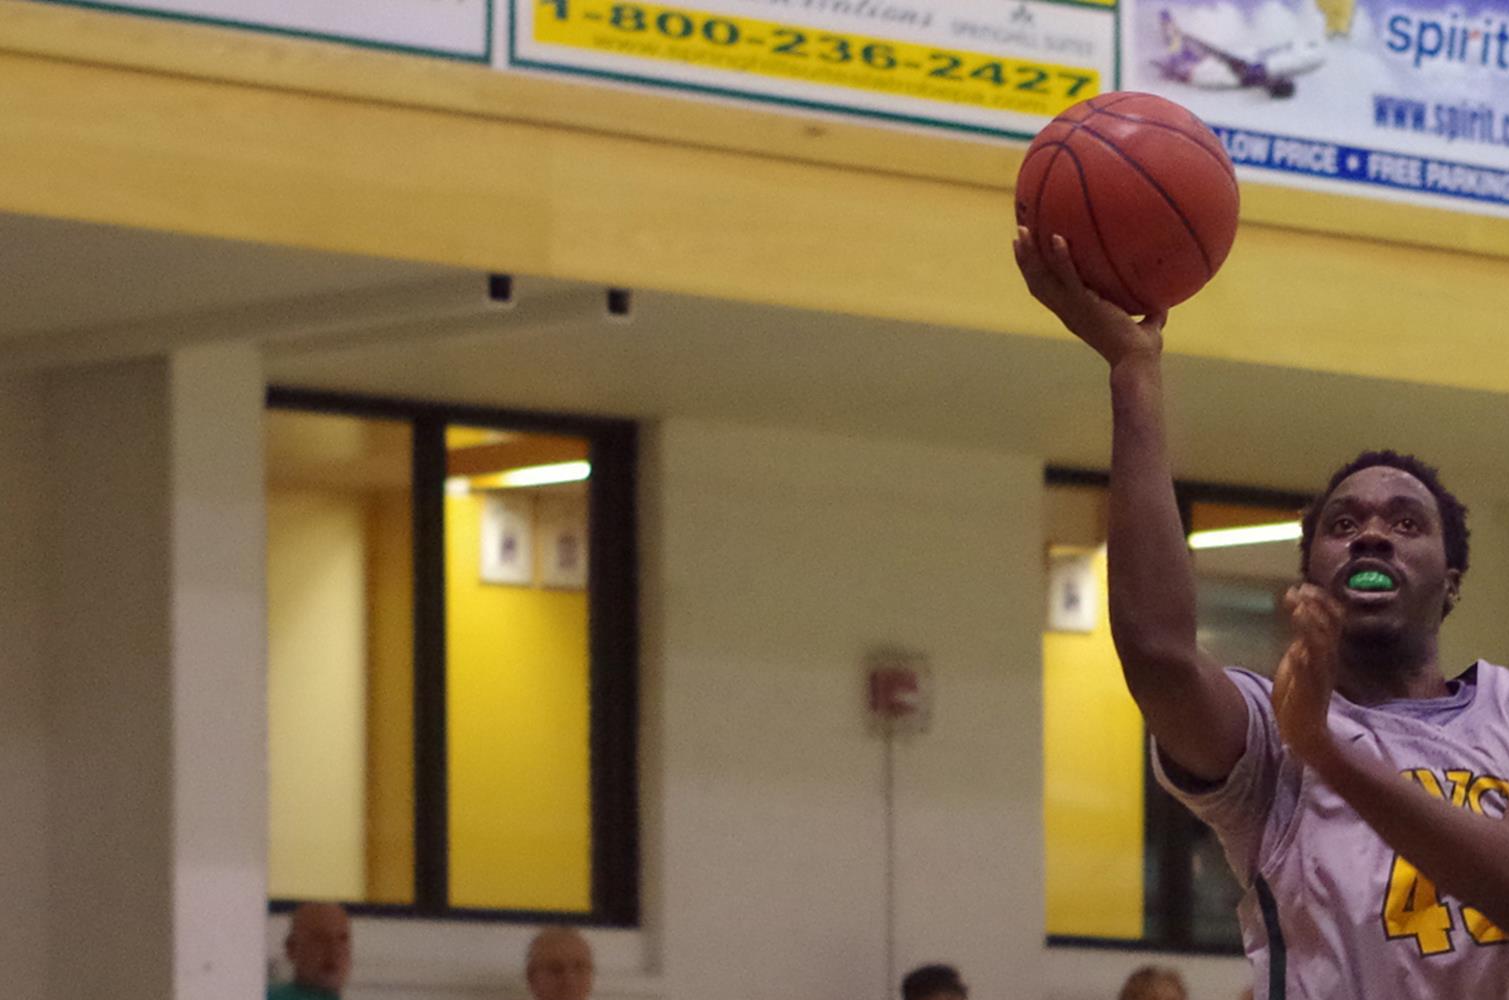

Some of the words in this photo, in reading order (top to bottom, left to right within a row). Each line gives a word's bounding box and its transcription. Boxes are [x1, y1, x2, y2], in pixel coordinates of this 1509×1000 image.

[540, 0, 1095, 98] 1-800-236-2427
[1222, 130, 1270, 165] LOW
[1273, 138, 1338, 174] PRICE
[1367, 152, 1421, 185] FREE
